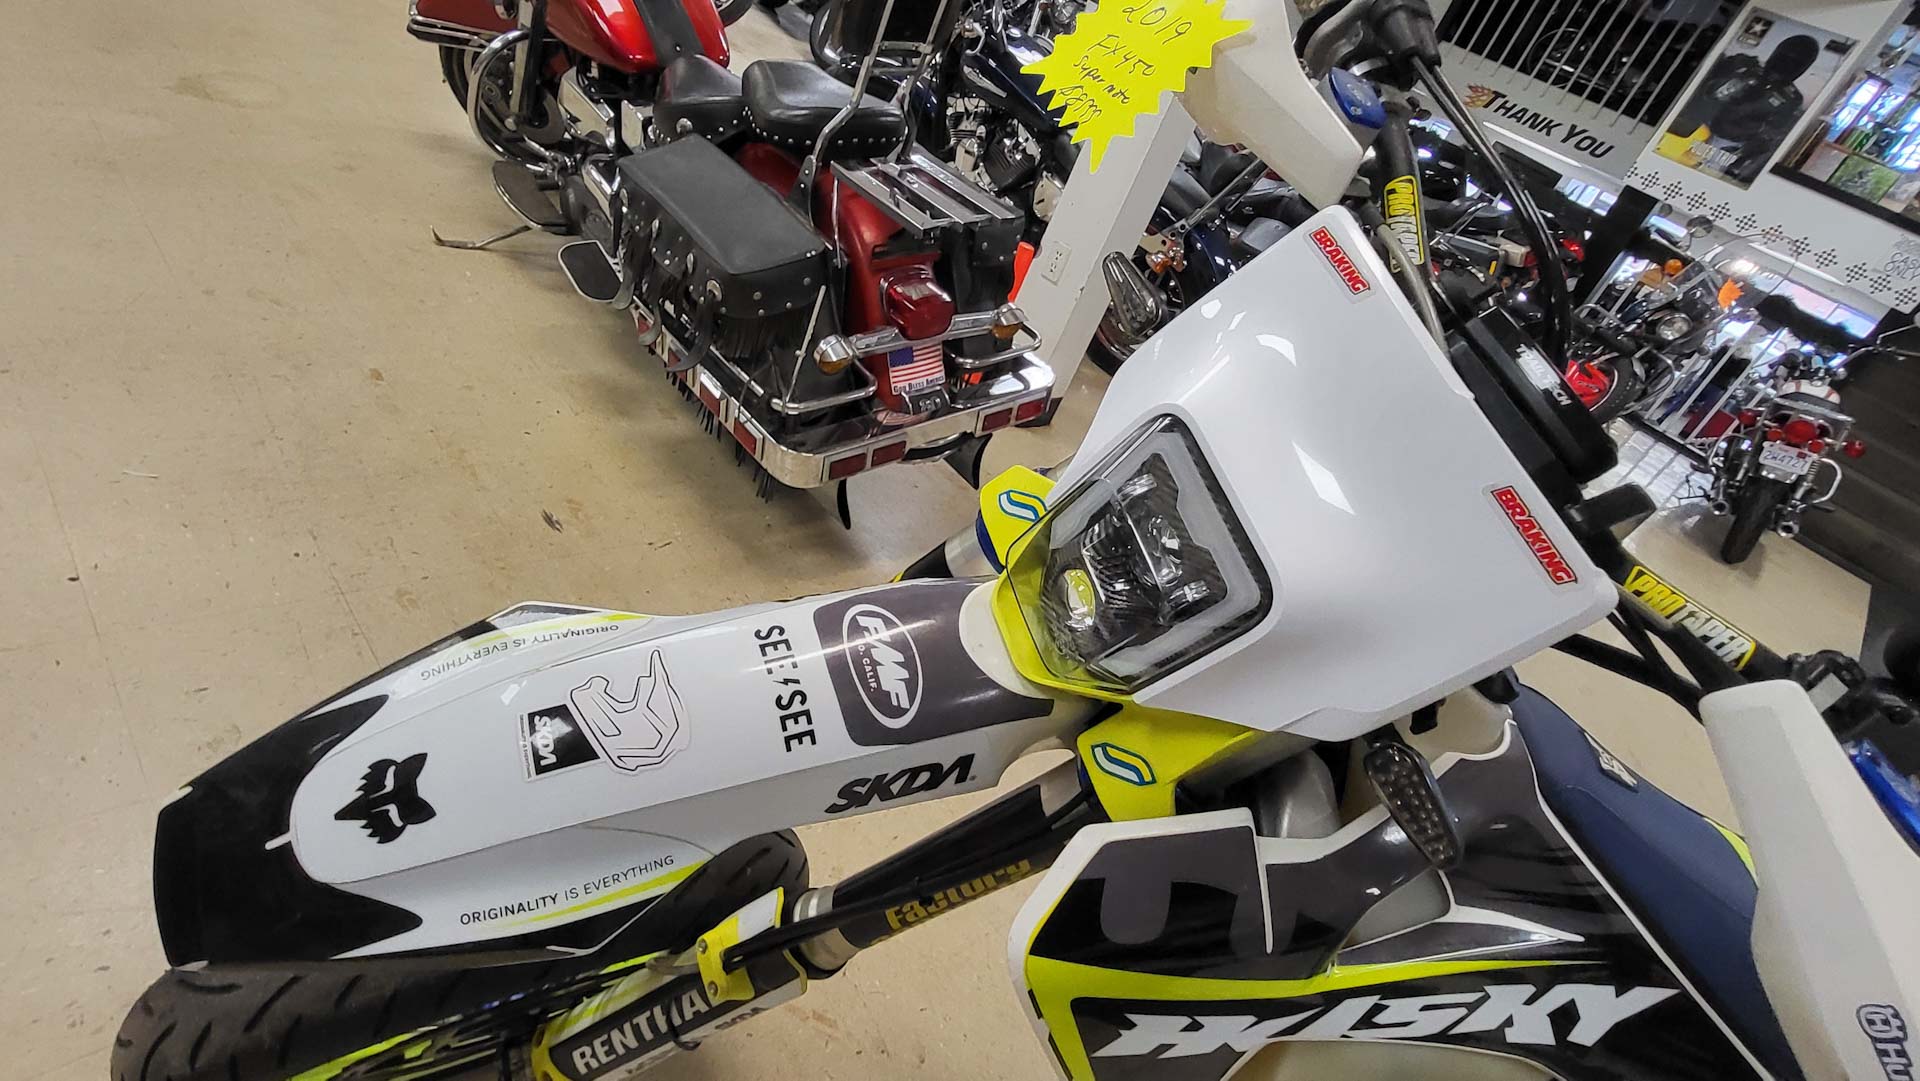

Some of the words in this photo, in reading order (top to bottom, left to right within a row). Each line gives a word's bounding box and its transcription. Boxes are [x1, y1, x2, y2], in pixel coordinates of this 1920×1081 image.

[1122, 0, 1192, 45] 2019
[1482, 90, 1563, 136] THANK
[1560, 124, 1615, 158] YOU
[1308, 226, 1370, 295] BRAKING
[1491, 486, 1577, 585] BRAKING
[421, 642, 508, 681] EVERYTHING
[512, 638, 526, 648] IS
[532, 624, 619, 645] ORIGINALITY
[754, 625, 798, 675] SEE
[856, 615, 910, 709] FMF
[862, 658, 878, 692] CALIF.
[775, 690, 817, 752] SEE
[824, 753, 976, 813] SKDA
[460, 893, 559, 926] ORIGINALITY
[564, 887, 579, 901] IS
[583, 855, 674, 895] EVERYTHING
[572, 989, 713, 1075] RENTHA
